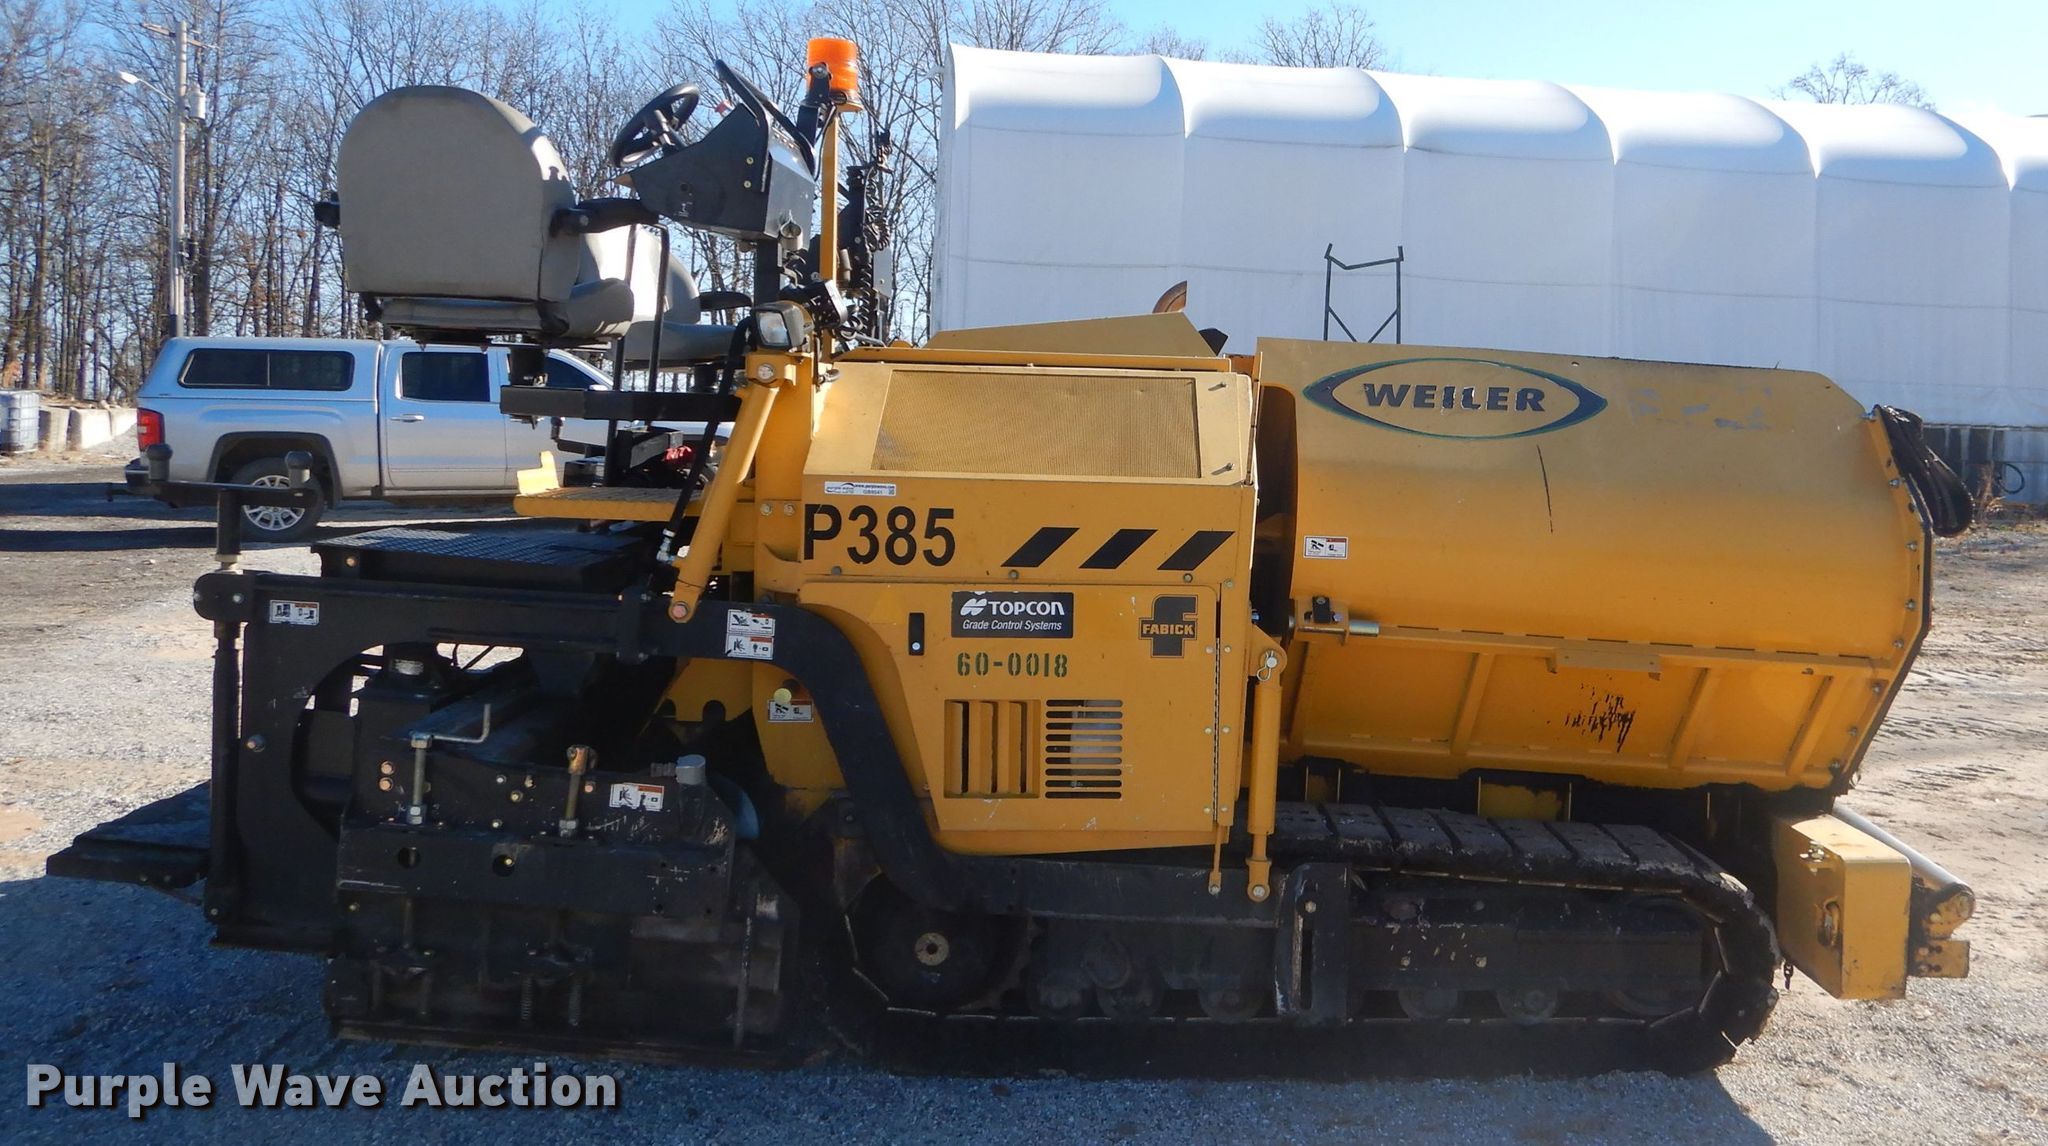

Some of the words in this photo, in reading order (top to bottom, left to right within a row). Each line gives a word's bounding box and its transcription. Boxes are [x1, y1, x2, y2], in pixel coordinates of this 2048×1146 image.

[1363, 382, 1546, 412] WEILER
[803, 503, 956, 567] P385
[988, 601, 1065, 616] TOPCON
[962, 619, 989, 630] Grade
[991, 619, 1023, 630] Control
[1024, 620, 1062, 632] Systems
[1142, 623, 1194, 636] FABICK
[957, 652, 1068, 678] 60-0018
